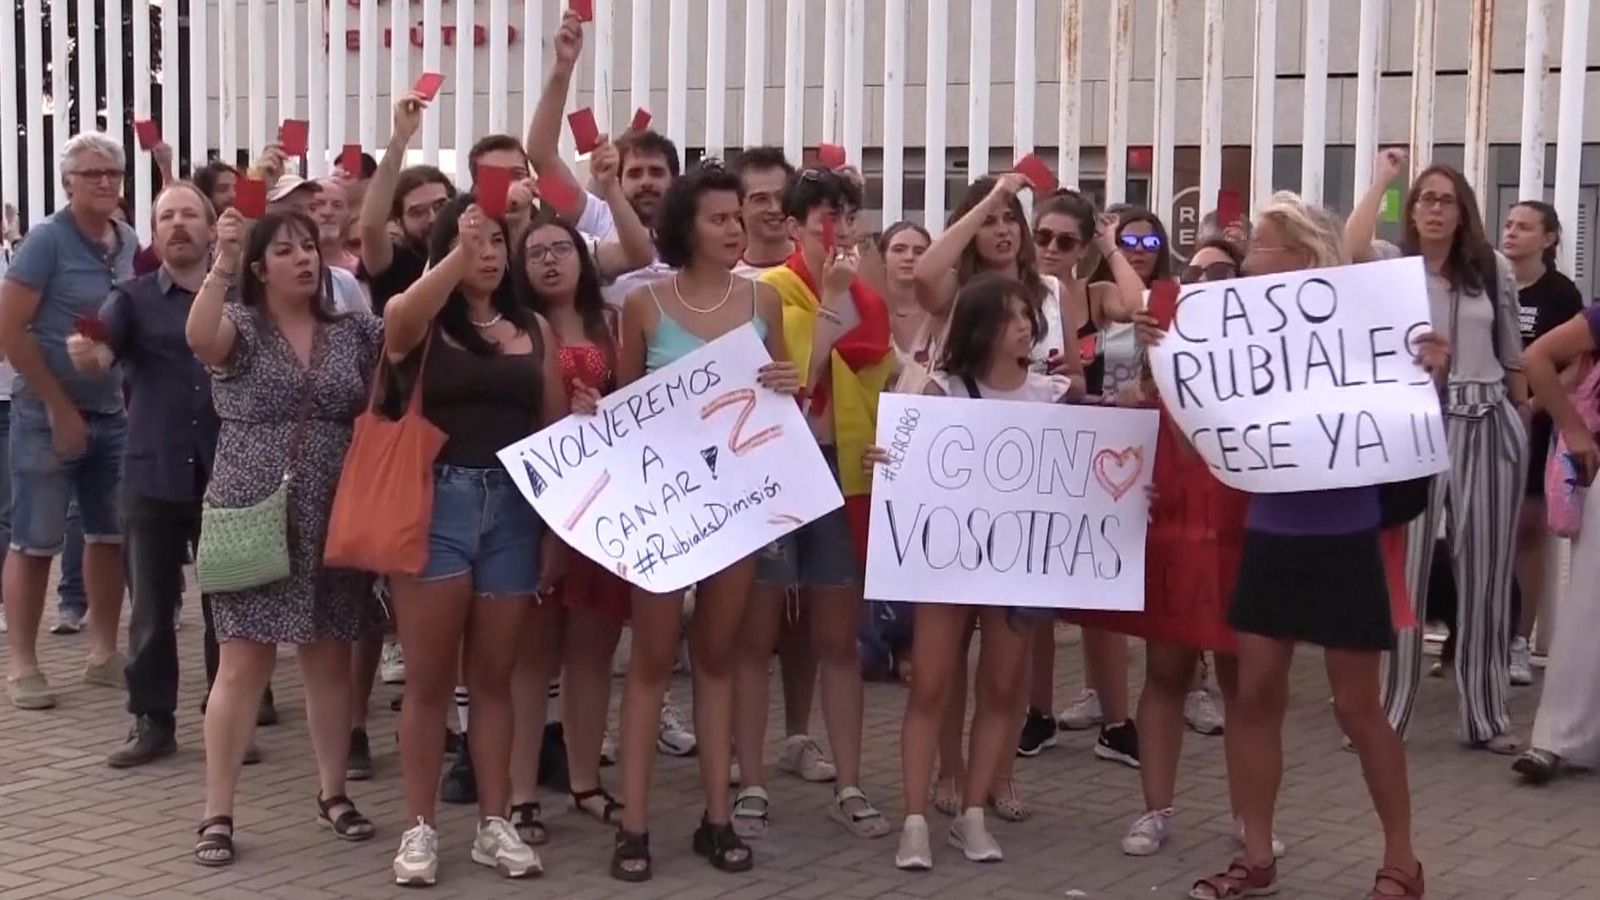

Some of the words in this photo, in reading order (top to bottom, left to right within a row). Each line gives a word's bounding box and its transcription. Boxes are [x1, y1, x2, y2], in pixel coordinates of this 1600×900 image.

[1173, 278, 1337, 343] CASO
[1173, 321, 1431, 409] RUBIALES
[520, 361, 721, 498] ¡VOLVEREMOS
[641, 445, 664, 484] A
[927, 424, 1096, 498] CON
[1191, 421, 1299, 472] CESE
[1317, 410, 1389, 469] YA
[885, 500, 1122, 580] VOSOTRAS
